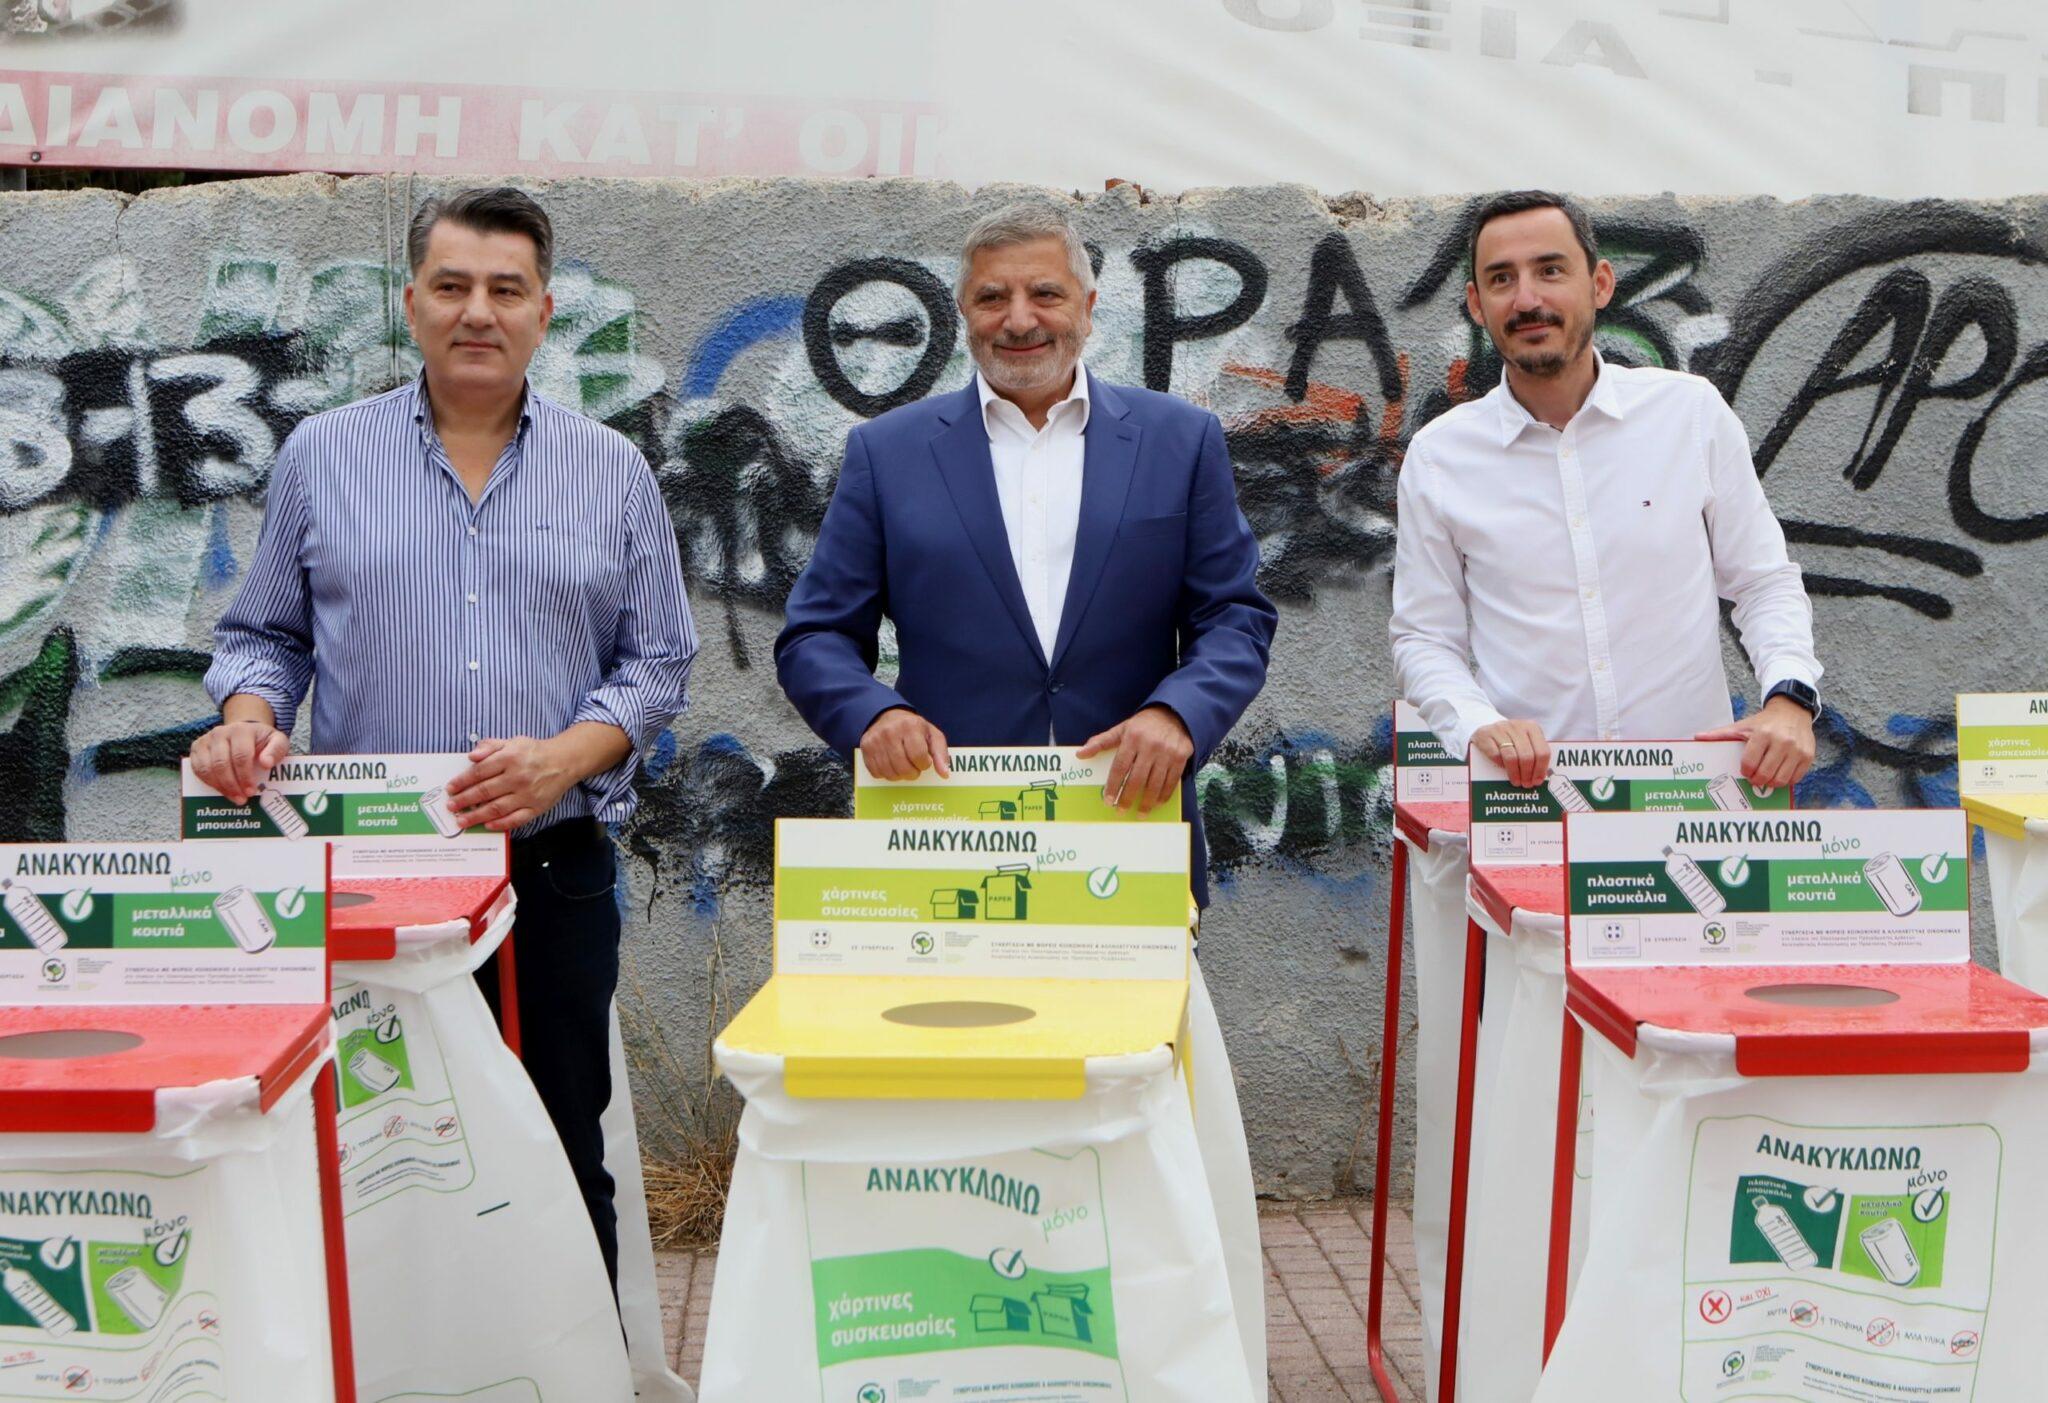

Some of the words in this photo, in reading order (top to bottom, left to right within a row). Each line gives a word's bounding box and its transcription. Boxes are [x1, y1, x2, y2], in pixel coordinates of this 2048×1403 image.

[0, 82, 461, 158] ΔΙΑΝΟΜΗ
[802, 222, 1403, 420] ΘΡΑ
[1408, 740, 1445, 749] πλαστι
[1556, 748, 1674, 767] ΑΝΑΚΥΚΛΩΝΩ
[269, 762, 387, 781] ΑΝΑΚΥΚΛΩΝΩ
[1062, 767, 1093, 786] μόνο
[1673, 762, 1704, 780] μόνο
[386, 774, 418, 792] μόνο
[1485, 790, 1539, 801] πλαστικά
[1645, 790, 1704, 801] μεταλλικά
[196, 805, 252, 818] πλαστικά
[357, 803, 418, 816] μεταλλικά
[1485, 804, 1549, 816] μπουκάλια
[196, 819, 261, 832] μπουκάλια
[357, 816, 398, 828] κουτιά
[888, 829, 1037, 853] ΑΝΑΚΥΚΛΩΝΩ
[1676, 820, 1822, 844] ΑΝΑΚΥΚΛΩΝΩ
[1821, 836, 1861, 858] μόνο
[16, 852, 171, 876] ΑΝΑΚΥΚΛΩΝΩ
[1036, 848, 1077, 872] μόνο
[170, 869, 212, 891] μόνο
[1587, 873, 1655, 888] πλαστικά
[1787, 873, 1861, 886] μεταλλικά
[822, 886, 887, 902] χάρτινες
[1787, 888, 1836, 902] κουτιά
[1905, 882, 1916, 897] CAN
[1587, 891, 1667, 907] μπουκάλια
[132, 906, 212, 921] μεταλλικά
[822, 902, 919, 920] συσκευασίες
[132, 923, 185, 937] κουτιά
[1757, 1134, 1921, 1171] ΑΝΑΚΥΚΛΩΝΩ
[866, 1166, 1041, 1216] ΑΝΑΚΥΚΛΩΝΩ
[1907, 1169, 1948, 1197] μόνο
[0, 1190, 153, 1218] ΝΑΚΥΚΛΩΝΩ
[143, 1215, 187, 1247] μόνο
[1042, 1204, 1088, 1244] μόνο
[828, 1291, 913, 1321] χάρτινες
[831, 1316, 957, 1347] συσκευασίες
